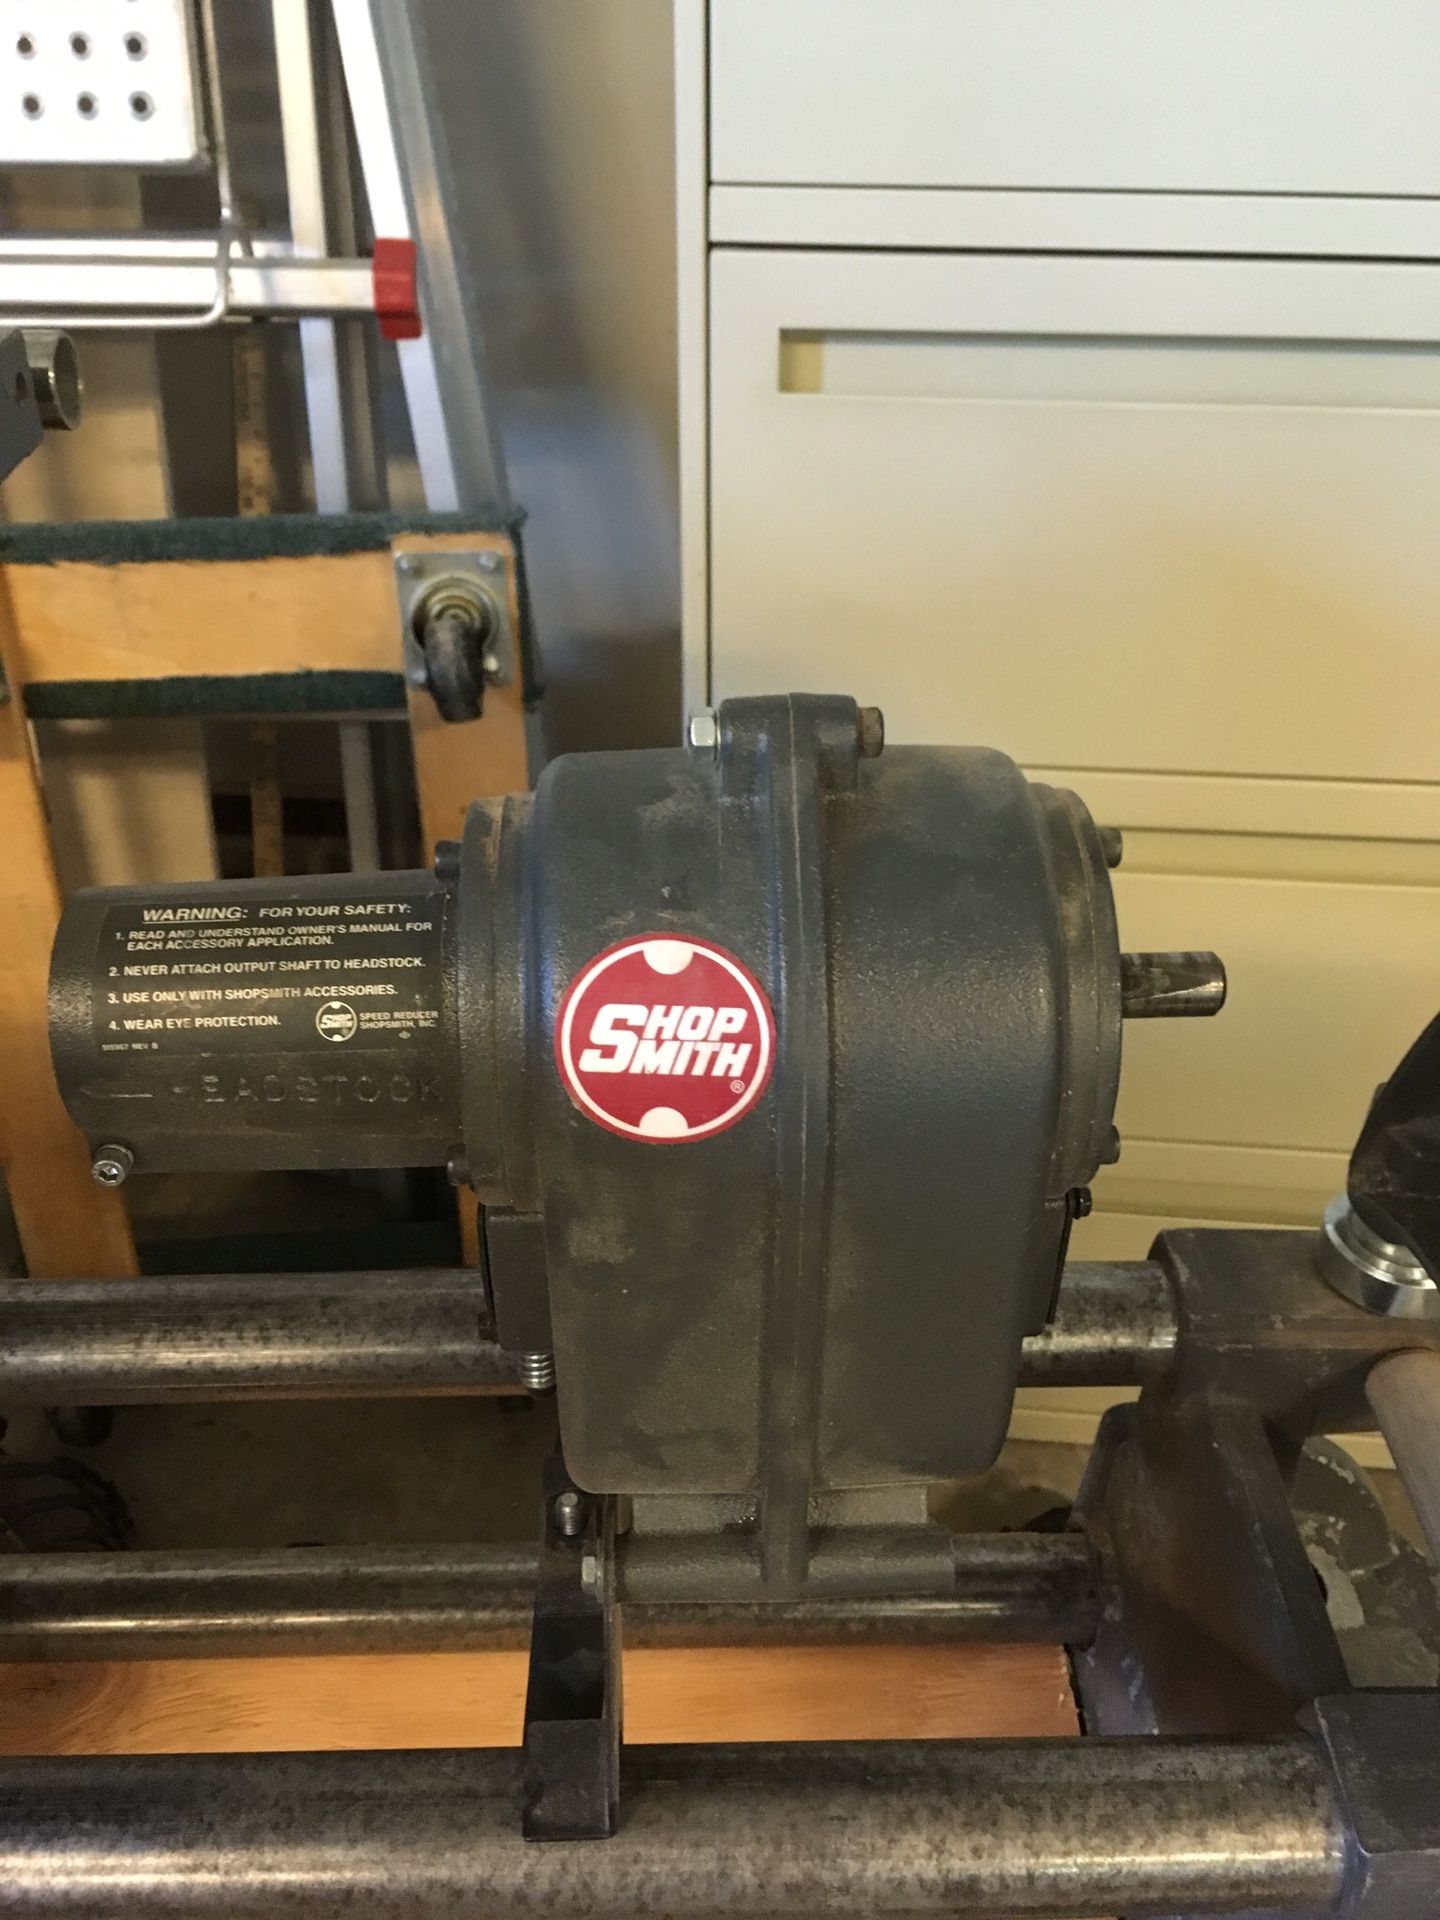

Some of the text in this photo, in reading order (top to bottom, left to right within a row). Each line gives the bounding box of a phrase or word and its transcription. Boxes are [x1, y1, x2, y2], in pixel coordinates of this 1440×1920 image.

[143, 903, 412, 921] WARNING: FOR YOUR SAFETY:
[115, 922, 432, 940] 1. READ AND UNDERSTAND OWNER'S MANUAL FOR
[127, 935, 334, 951] EACH ACCESSORY APPLICATION.
[108, 957, 426, 977] 2. NEVER ATTACH OUTPUT SHAFT TO HEADSTOCK.
[107, 992, 119, 1004] 3.
[123, 992, 150, 1003] USE
[152, 991, 186, 1002] ONLY
[188, 989, 222, 1001] WITH
[304, 984, 398, 997] ACCESSORIES.
[108, 1015, 281, 1031] 4. WEAR EYE PROTECTION.
[359, 1010, 439, 1020] SPEED REDUCER
[579, 1003, 748, 1055] SHOP
